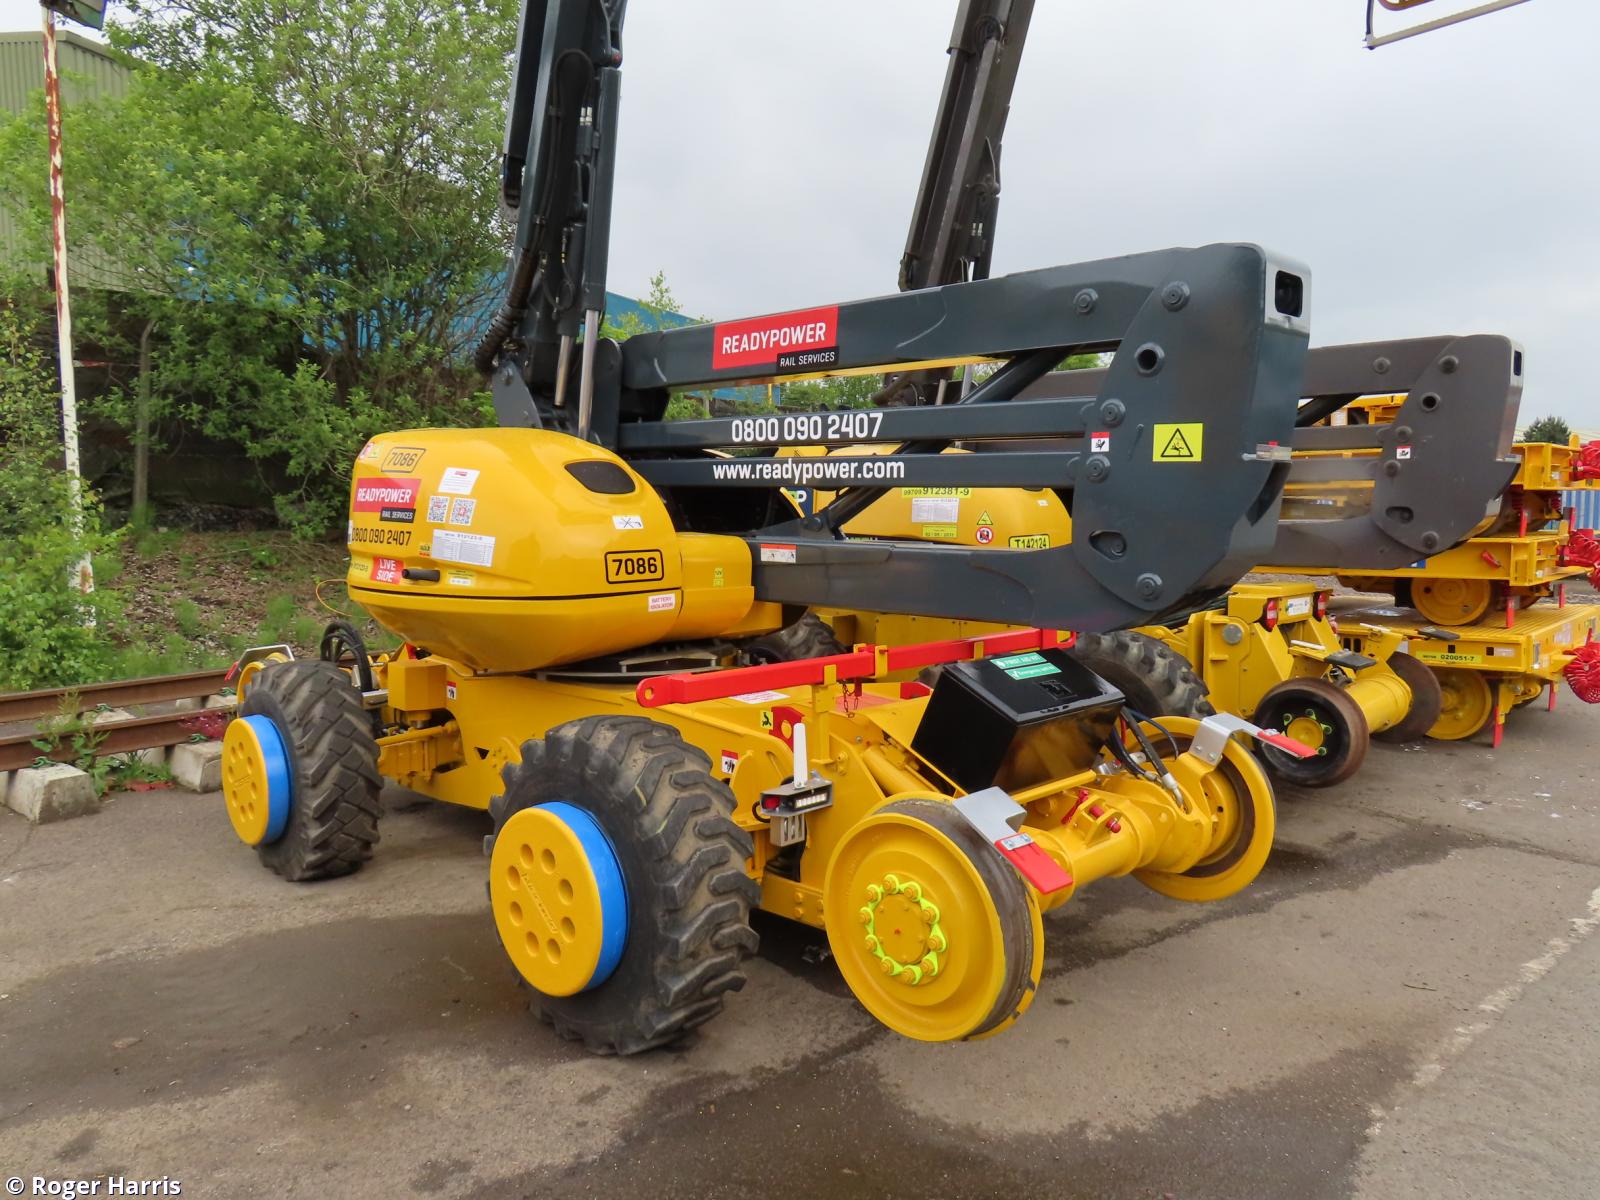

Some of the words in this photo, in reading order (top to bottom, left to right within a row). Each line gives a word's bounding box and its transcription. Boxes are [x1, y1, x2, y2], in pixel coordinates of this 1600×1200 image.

[722, 322, 826, 355] READYPOWER
[780, 355, 796, 367] RAIL
[798, 351, 835, 366] SERVICES
[731, 418, 778, 443] 0800
[783, 415, 822, 440] 090
[828, 412, 884, 439] 2407
[387, 451, 418, 467] 7086
[713, 458, 905, 484] www.readypower.com
[356, 487, 412, 503] READYPOWER
[381, 510, 391, 518] RAIL
[392, 510, 413, 520] SERVICES
[352, 527, 368, 542] 0800
[369, 528, 385, 544] 090
[386, 530, 412, 546] 2407
[379, 558, 396, 571] LIVE
[612, 556, 658, 576] 7086
[376, 570, 395, 582] SIDE
